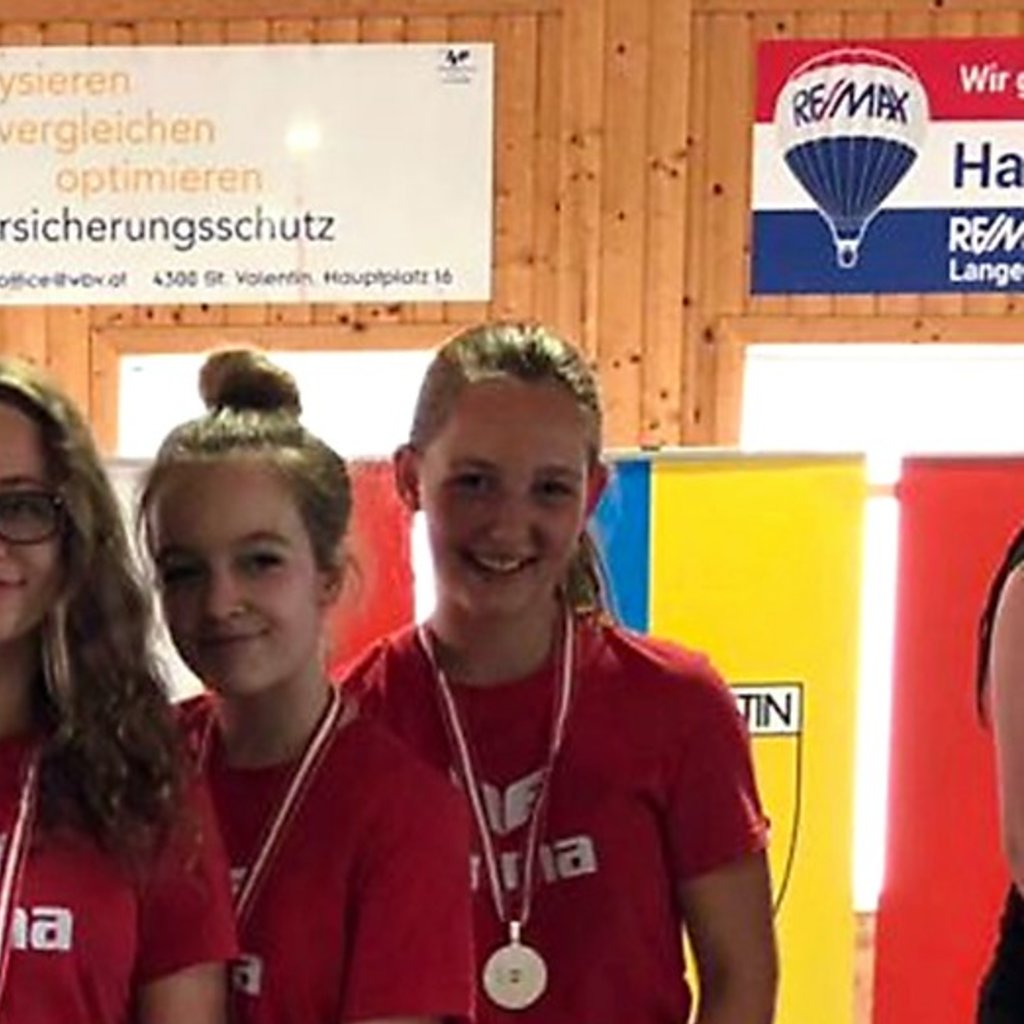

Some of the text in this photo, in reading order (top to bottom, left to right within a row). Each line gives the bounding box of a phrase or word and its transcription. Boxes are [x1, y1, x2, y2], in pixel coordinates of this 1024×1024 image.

[960, 62, 1011, 93] Wir
[793, 79, 909, 127] RE/MAX
[54, 158, 263, 201] optimieren
